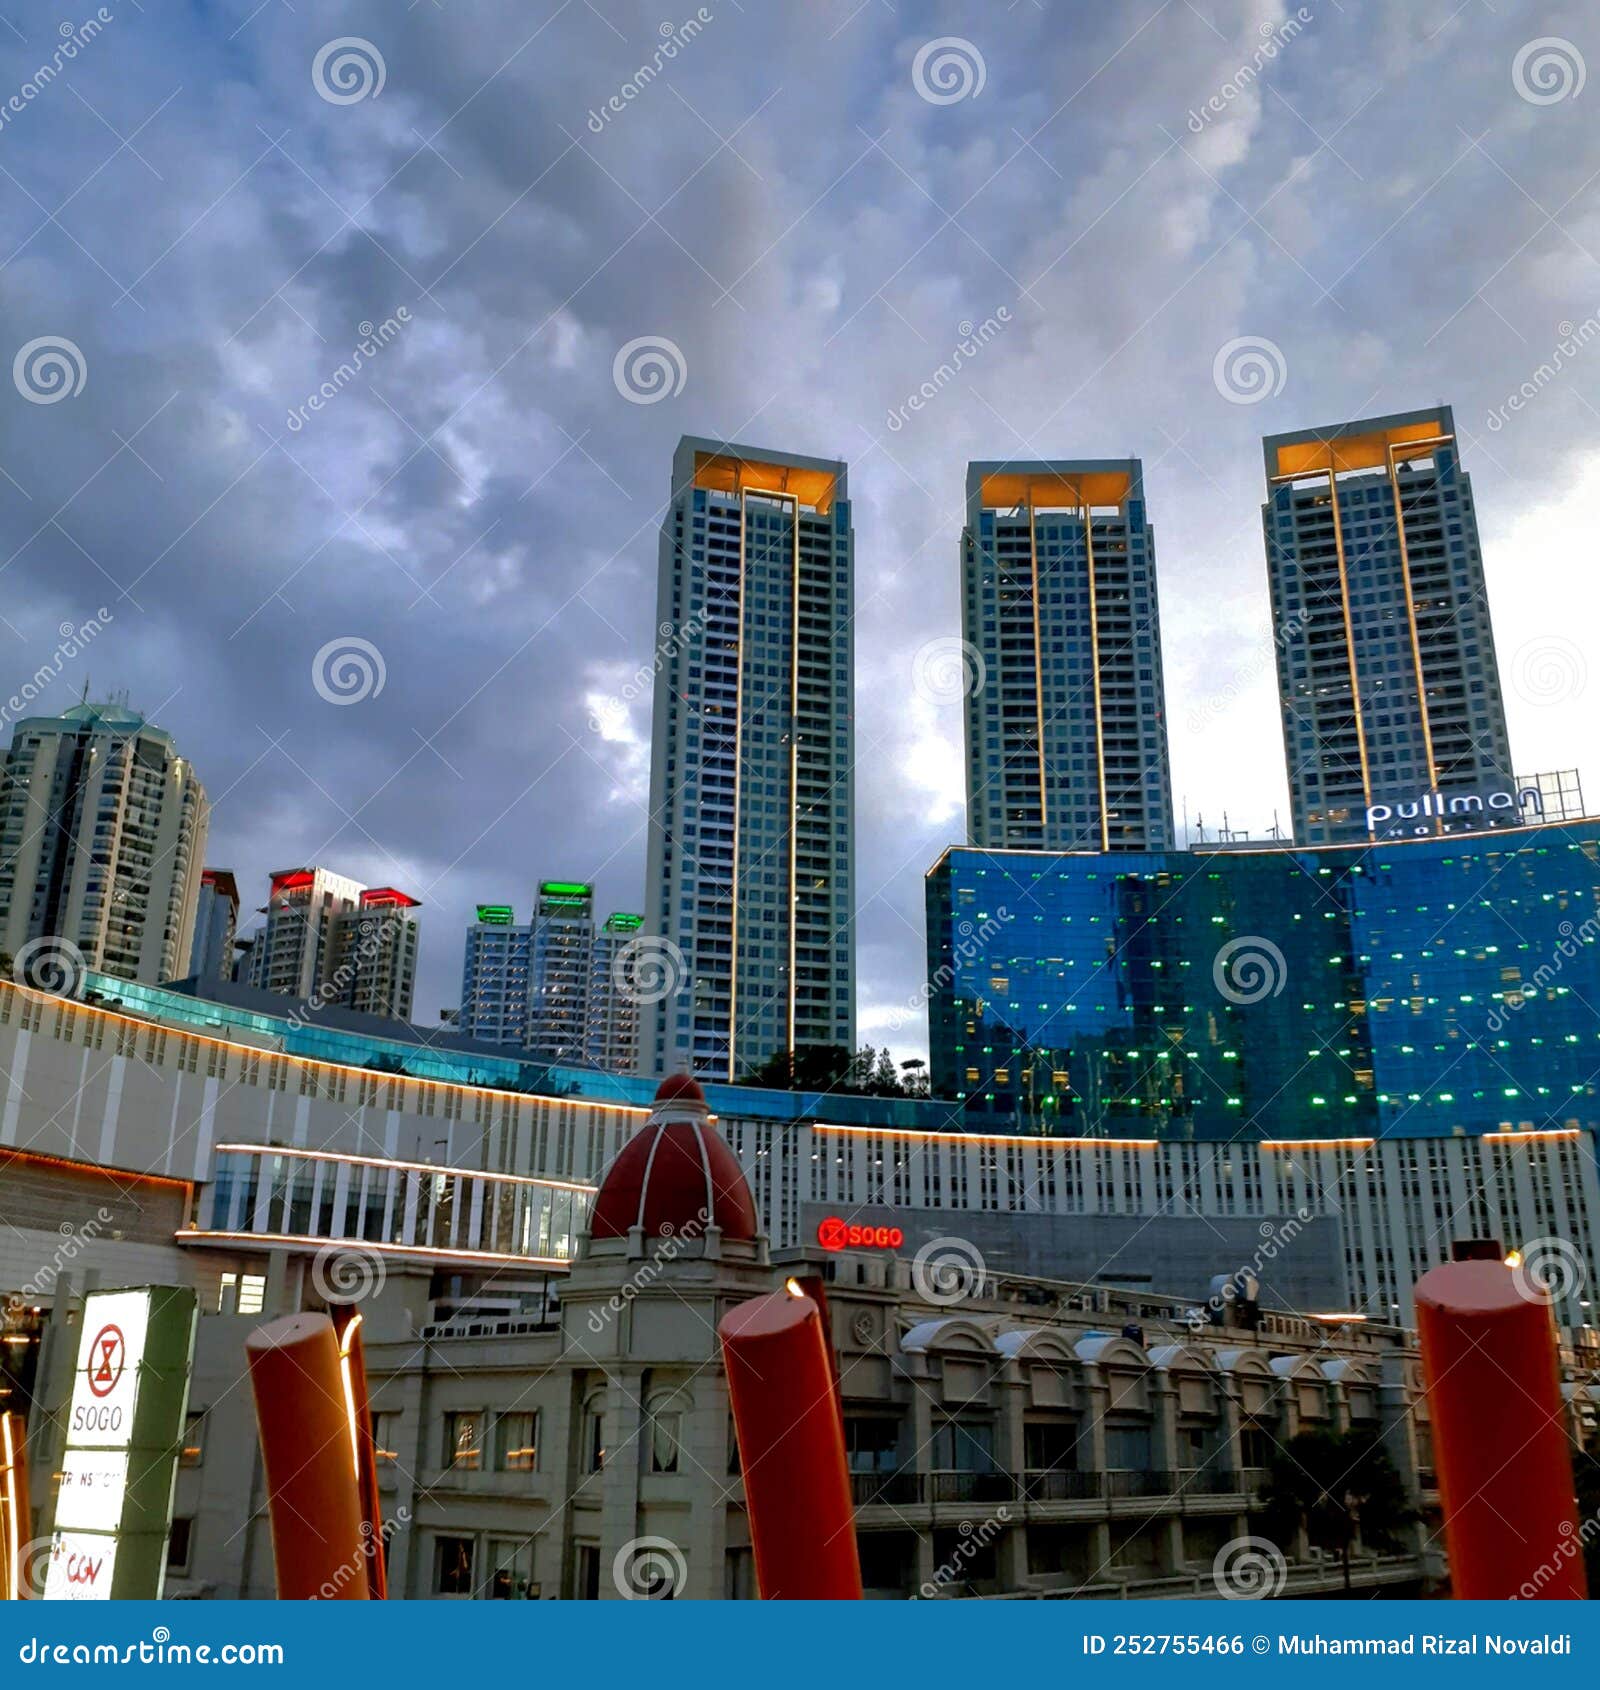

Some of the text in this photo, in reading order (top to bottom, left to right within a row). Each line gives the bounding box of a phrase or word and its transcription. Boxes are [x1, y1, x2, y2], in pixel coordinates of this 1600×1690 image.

[1366, 786, 1543, 831] pullman
[1389, 816, 1525, 837] HOTELS
[849, 1224, 904, 1248] SOGO
[73, 1405, 122, 1431] SOGO
[67, 1552, 102, 1585] CGV
